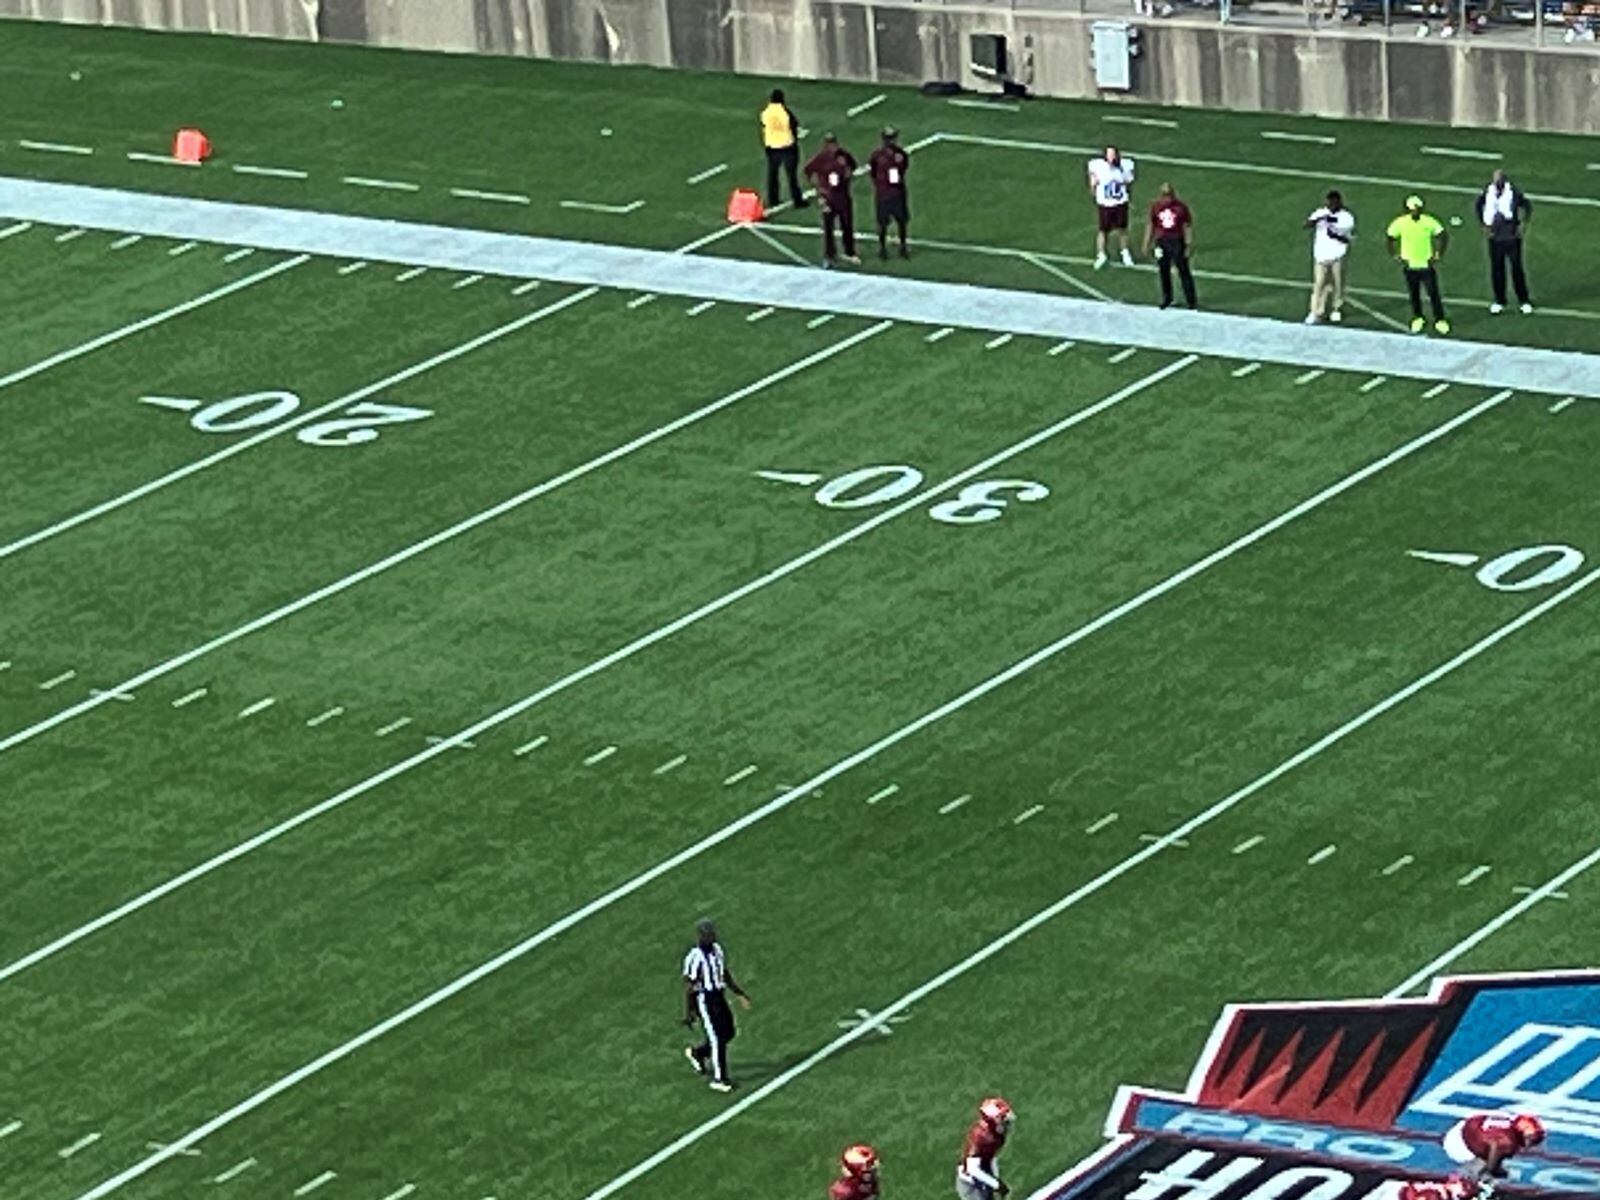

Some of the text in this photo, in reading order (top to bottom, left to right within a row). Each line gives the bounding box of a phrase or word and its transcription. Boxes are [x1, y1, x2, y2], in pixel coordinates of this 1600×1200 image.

[189, 390, 434, 446] 20
[813, 464, 1051, 524] 30
[1162, 1110, 1415, 1162] PRO
